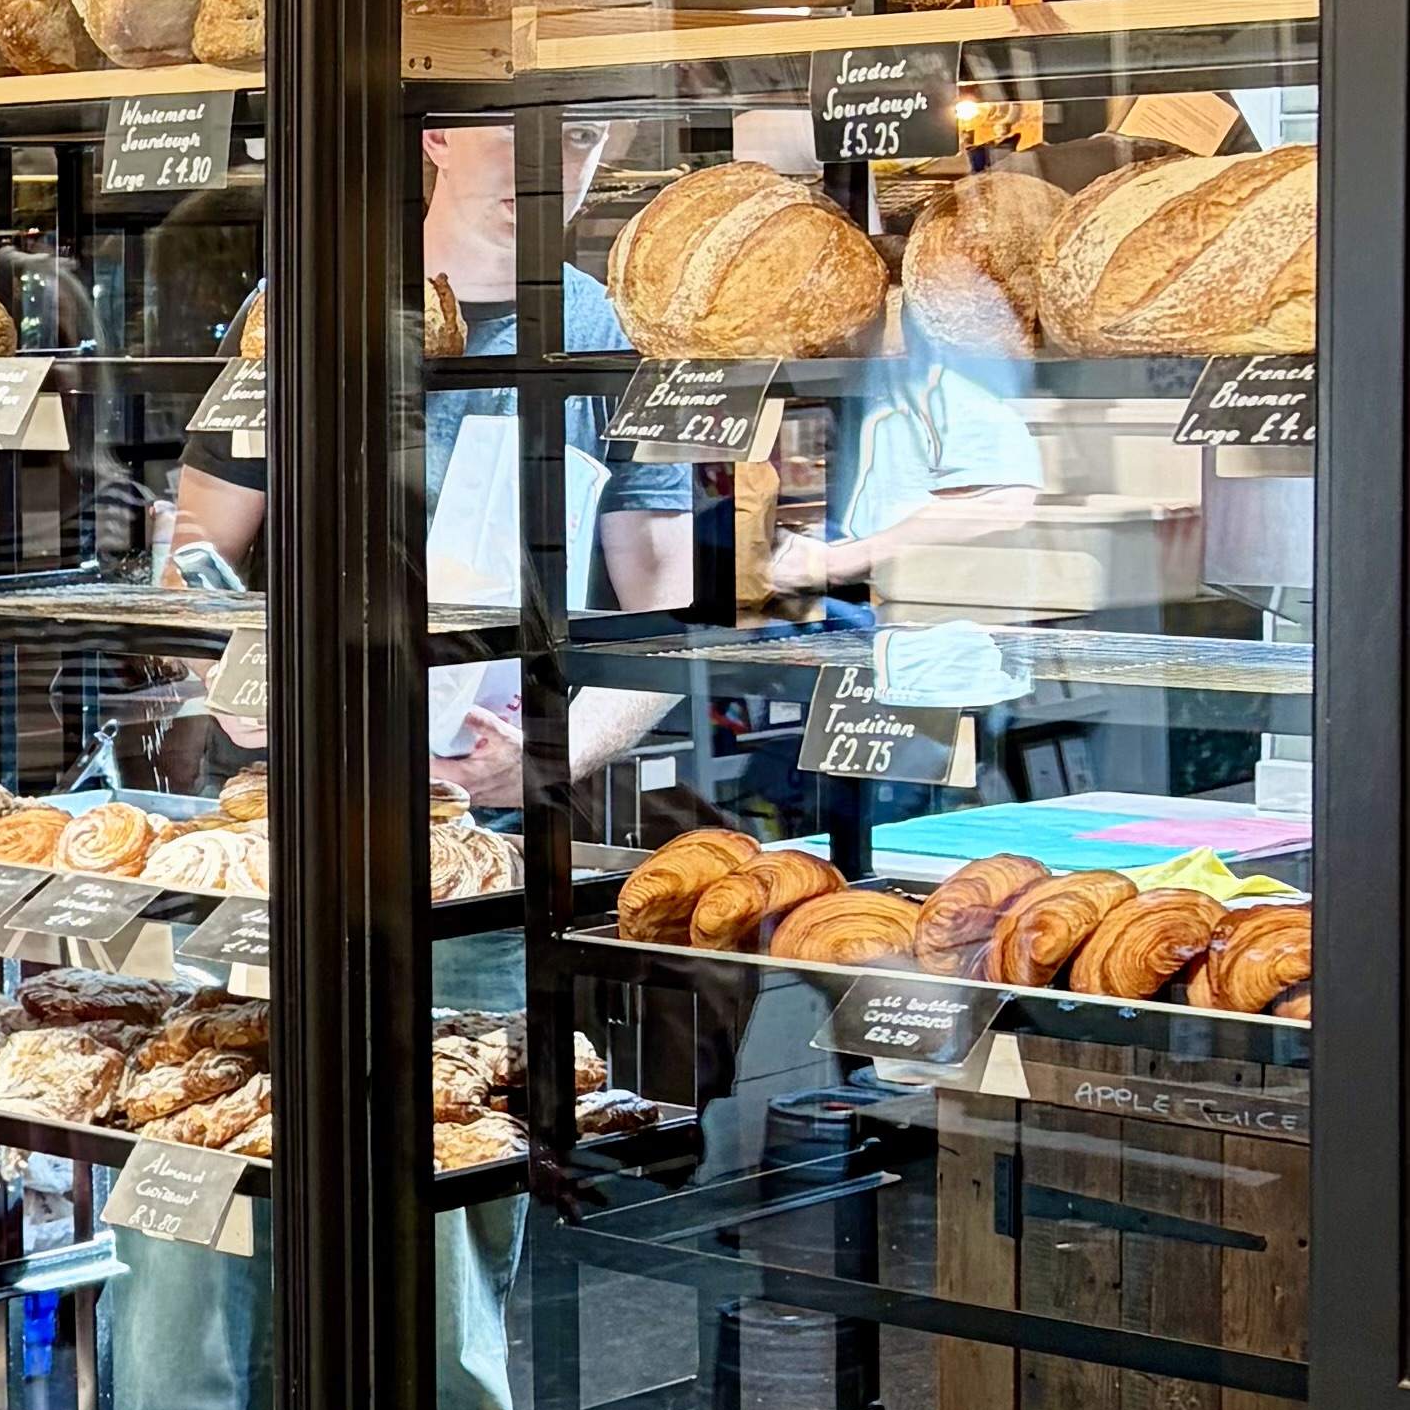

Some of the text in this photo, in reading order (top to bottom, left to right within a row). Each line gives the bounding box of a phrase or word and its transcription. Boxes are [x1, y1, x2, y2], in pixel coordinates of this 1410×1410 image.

[837, 50, 907, 85] Seeded
[119, 100, 206, 126] Wholemeal
[822, 87, 928, 122] Sourdough
[121, 126, 201, 154] Sourdough
[839, 121, 900, 158] £5.25
[106, 156, 213, 192] Large £4.80
[666, 359, 725, 383] French
[1236, 355, 1316, 382] French
[645, 382, 728, 407] Bloomer
[1209, 380, 1307, 409] Bloomer
[610, 412, 749, 446] Small £2.90
[1175, 413, 1241, 446] Large
[825, 703, 915, 738] Tradition
[819, 734, 894, 772] £2.75
[1074, 1081, 1171, 1114] APPLE
[142, 1152, 207, 1184] Almond
[127, 1204, 182, 1234] £3.80
